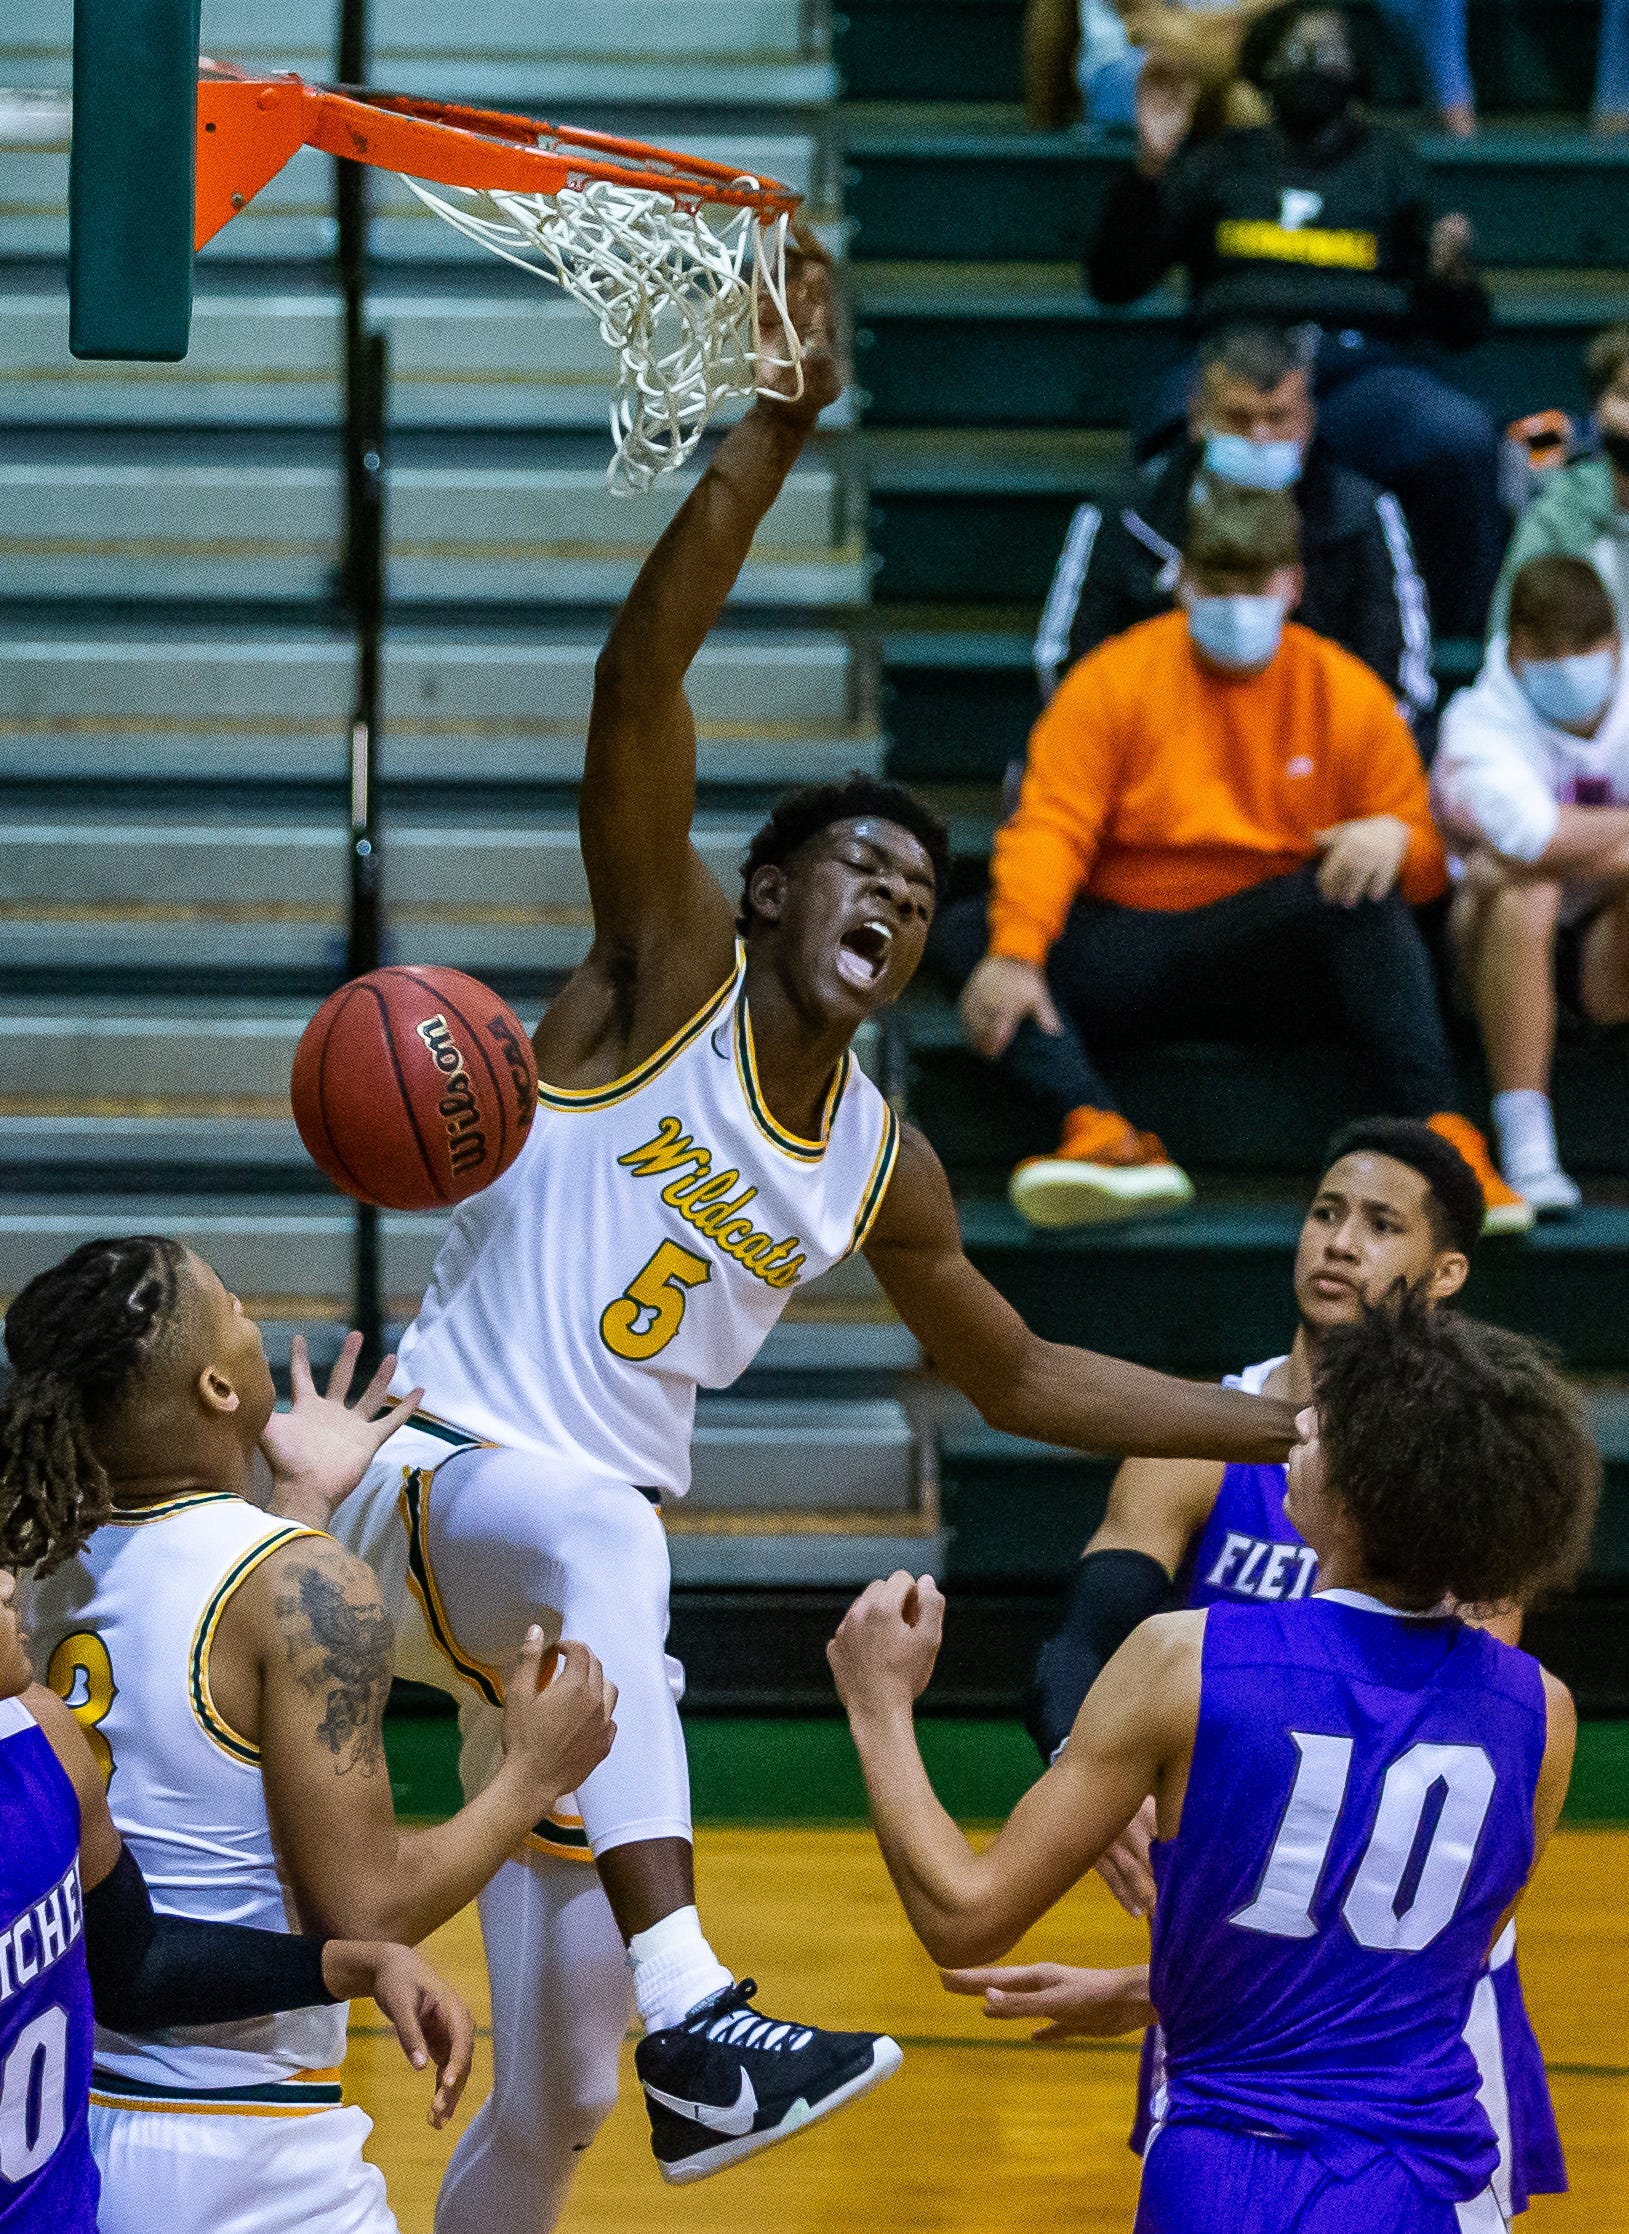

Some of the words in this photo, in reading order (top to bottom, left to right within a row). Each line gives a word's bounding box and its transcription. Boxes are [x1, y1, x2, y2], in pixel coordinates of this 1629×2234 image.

[416, 1013, 487, 1178] Wilson
[617, 1116, 806, 1288] Wildcats
[600, 1237, 713, 1362] 5
[1228, 1730, 1497, 1952] 10
[0, 1852, 83, 2001] TCHE
